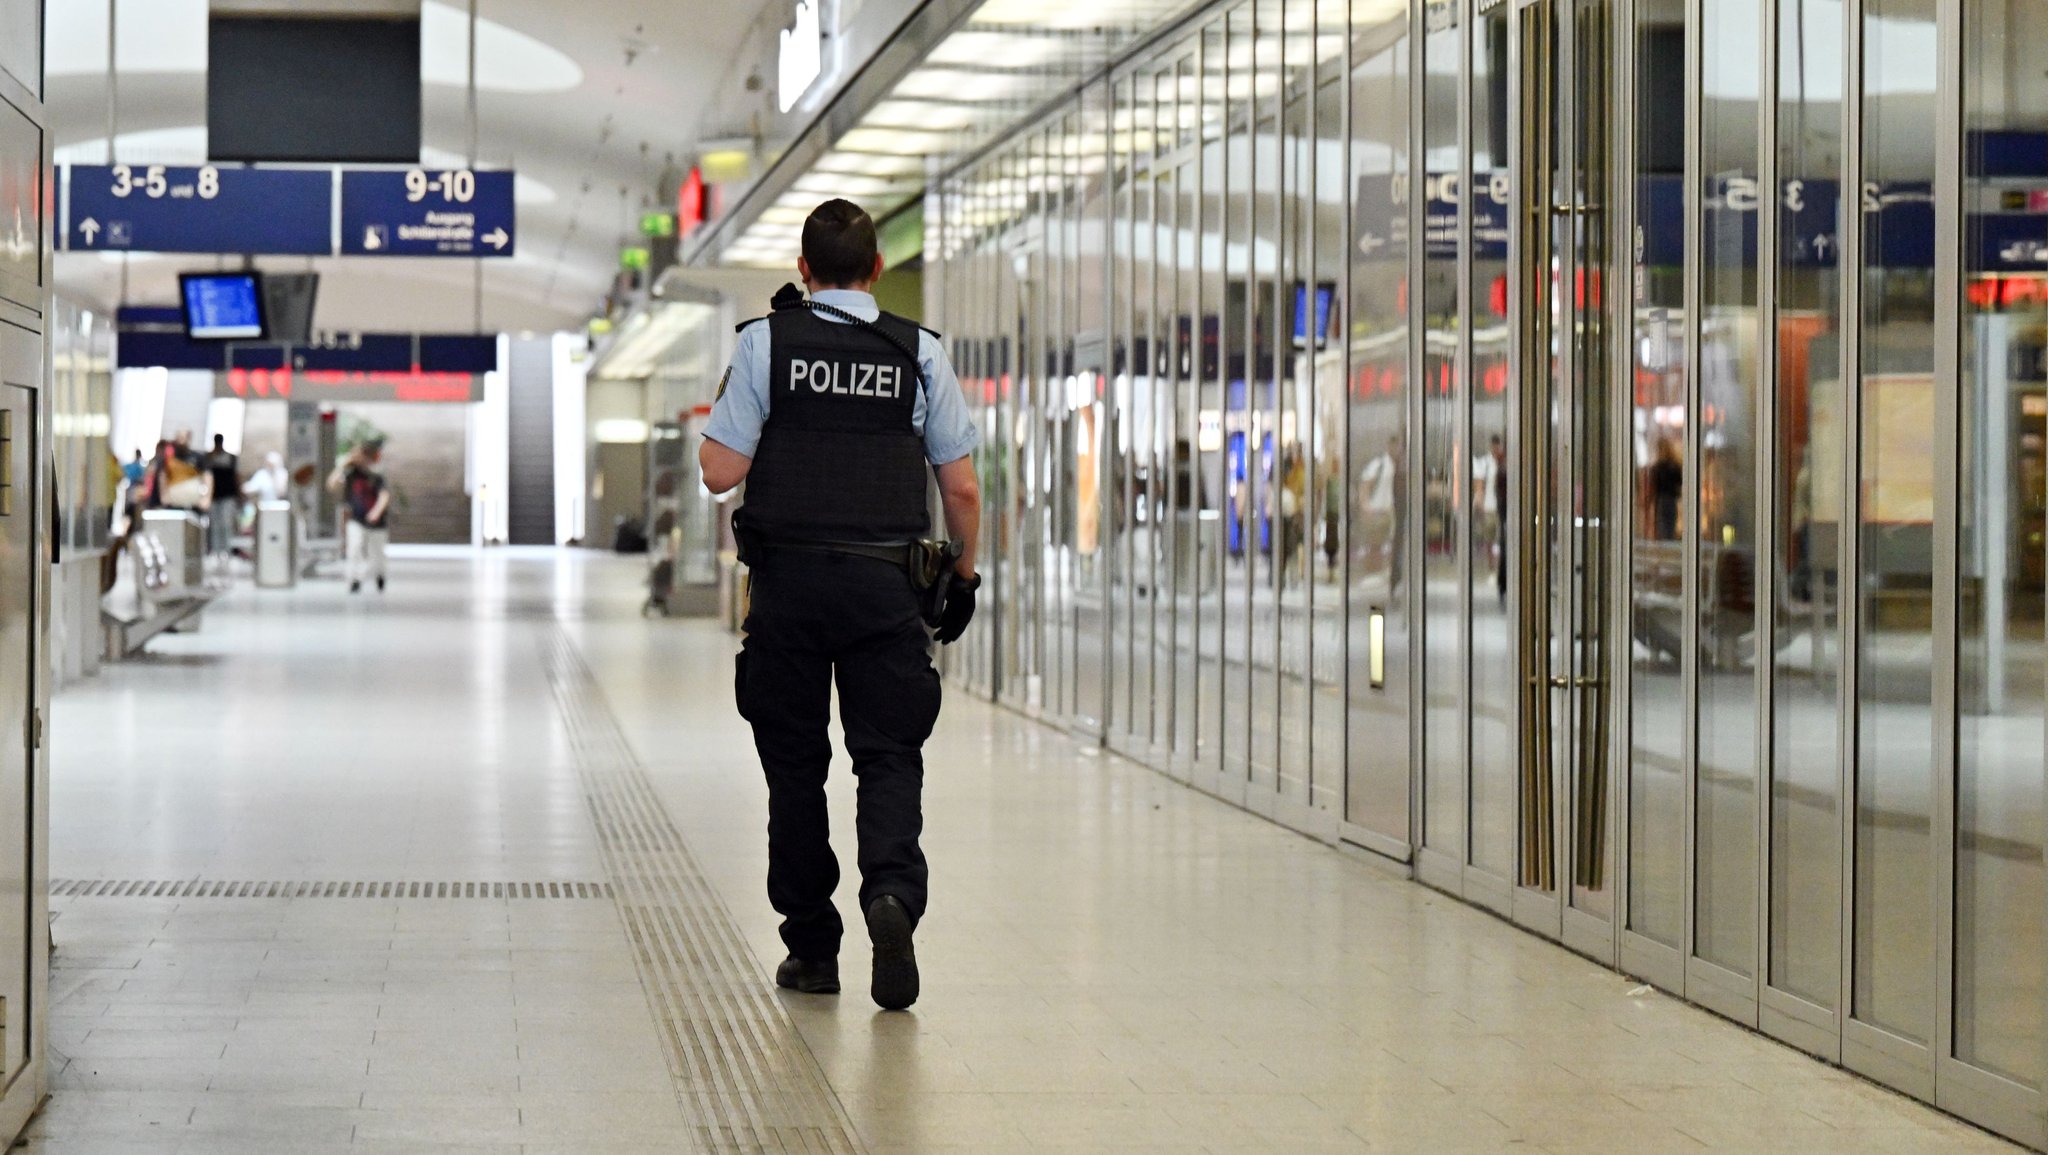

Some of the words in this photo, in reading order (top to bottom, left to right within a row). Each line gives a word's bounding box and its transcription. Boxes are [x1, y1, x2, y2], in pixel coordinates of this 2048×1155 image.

[111, 164, 167, 198] 3-5
[198, 165, 219, 199] 8
[405, 169, 475, 202] 9-10
[789, 359, 901, 398] POLIZEI
